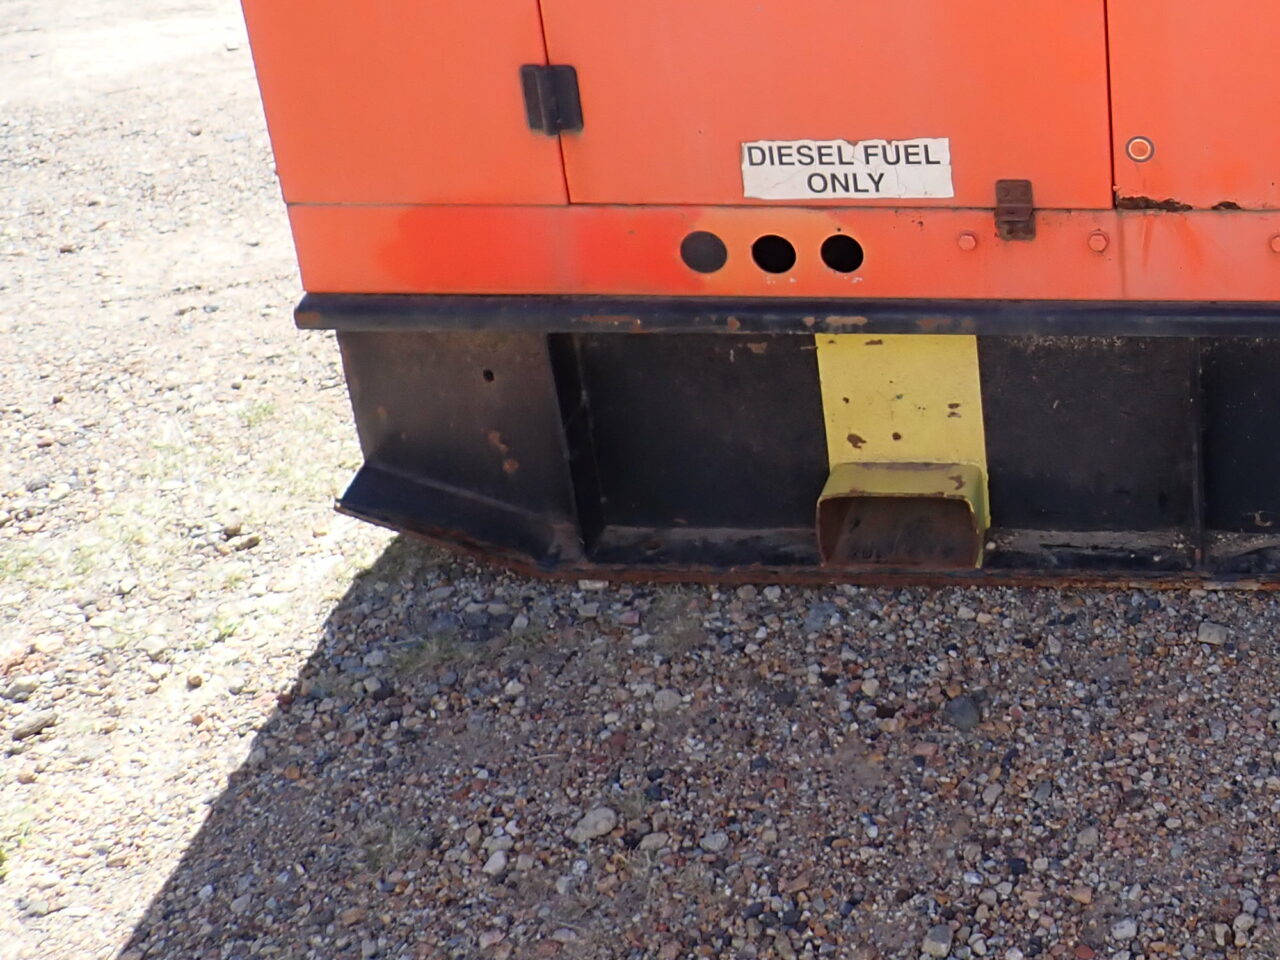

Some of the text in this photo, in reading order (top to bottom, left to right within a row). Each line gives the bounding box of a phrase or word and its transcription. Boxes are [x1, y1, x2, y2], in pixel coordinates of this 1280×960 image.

[747, 144, 941, 166] DIESEL FUEL
[807, 172, 885, 193] ONLY
